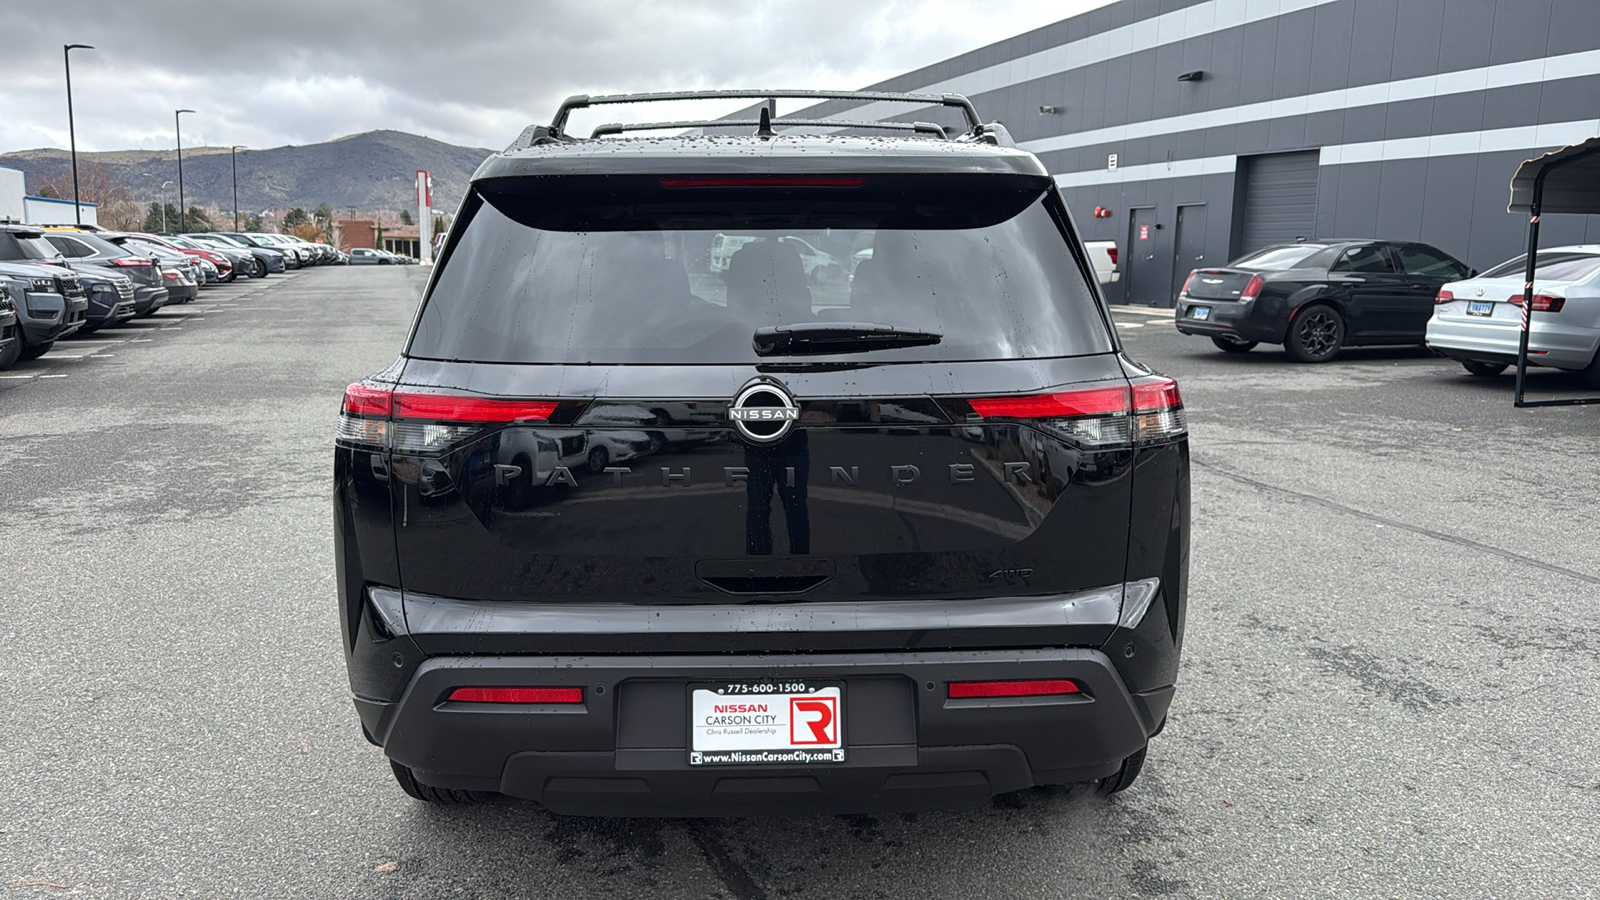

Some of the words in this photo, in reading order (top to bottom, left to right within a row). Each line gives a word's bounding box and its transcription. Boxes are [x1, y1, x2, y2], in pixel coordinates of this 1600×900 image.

[731, 410, 797, 419] NISSAN
[493, 461, 1033, 487] PATHFINDER
[727, 683, 805, 693] 775-600-1500
[714, 704, 768, 713] NISSAN
[705, 715, 752, 725] CARSON
[754, 715, 777, 724] CITY
[706, 728, 722, 736] Chris
[744, 727, 777, 736] Dealership
[703, 751, 832, 763] www.NissanCarsonCity.com
